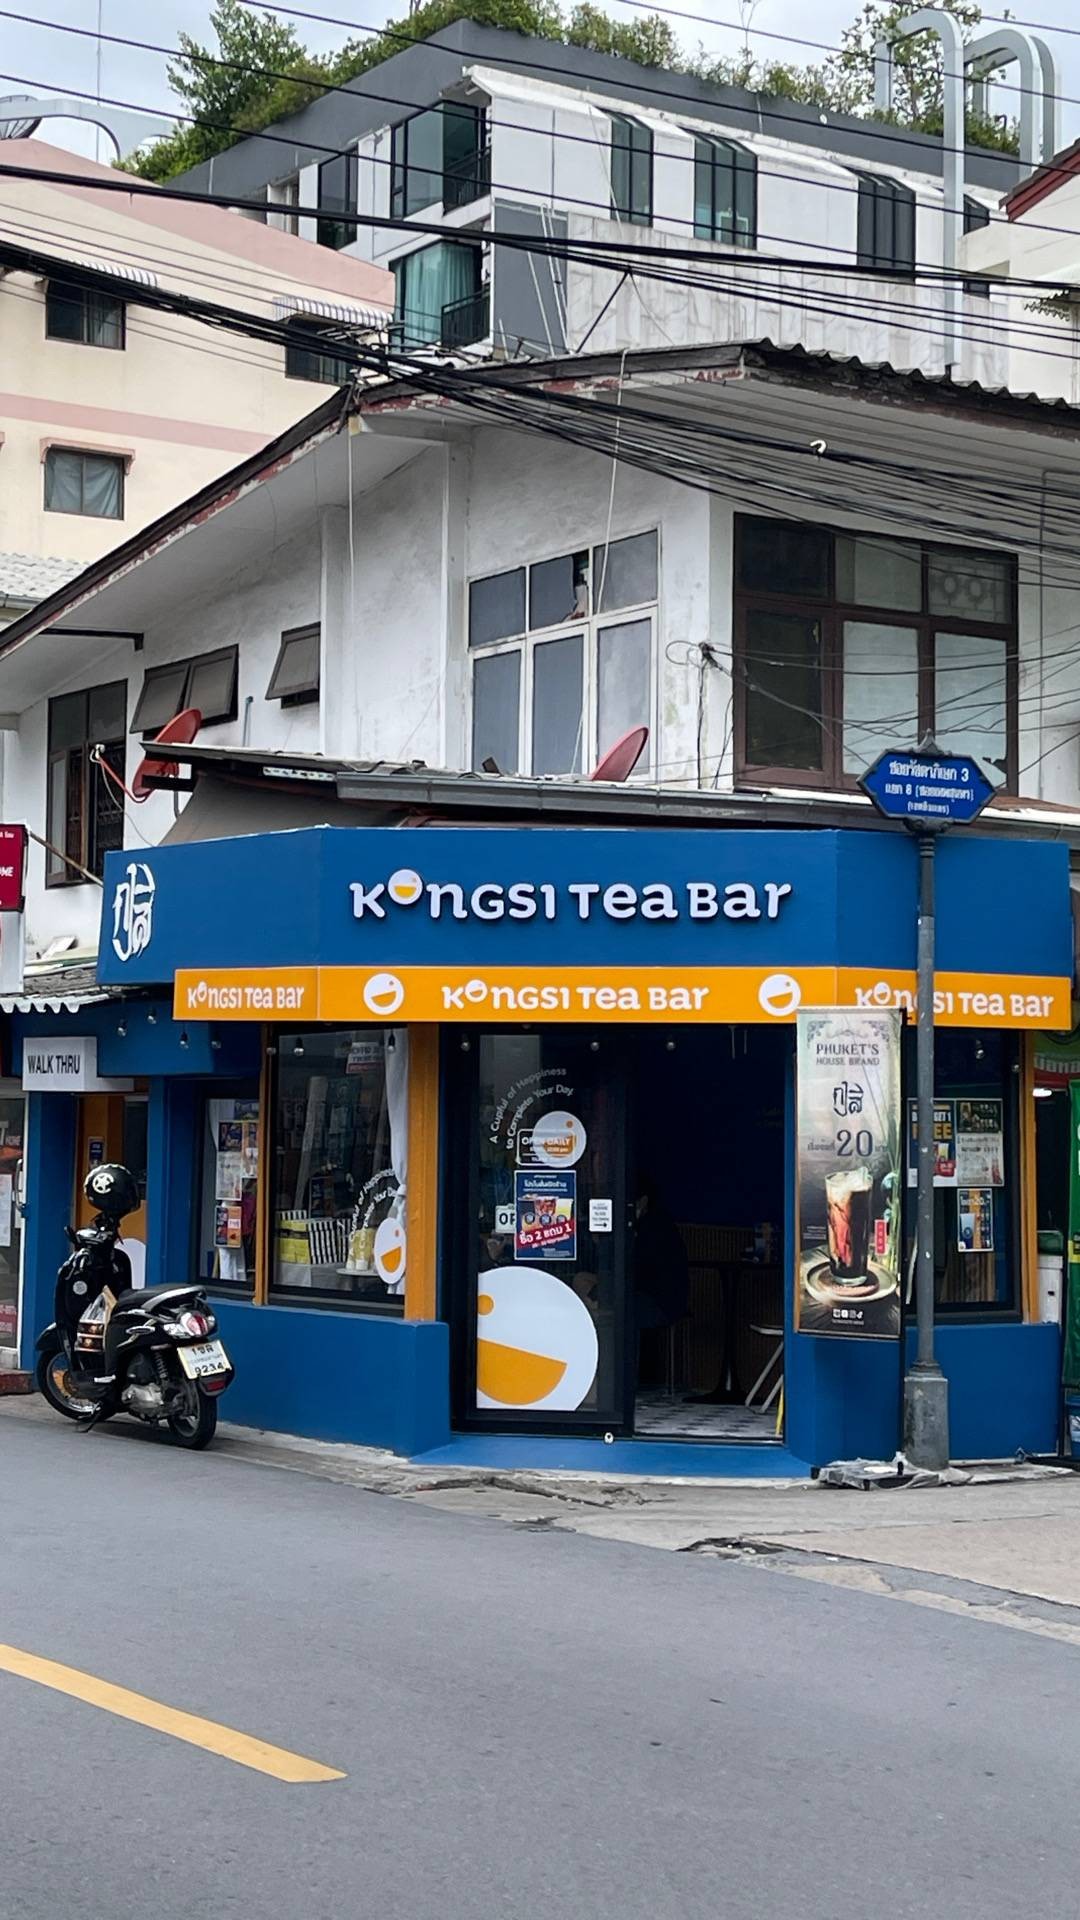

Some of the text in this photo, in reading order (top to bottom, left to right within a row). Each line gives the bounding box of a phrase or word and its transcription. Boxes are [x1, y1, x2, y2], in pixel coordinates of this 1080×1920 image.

[961, 768, 969, 782] 3
[905, 783, 912, 795] 8
[568, 883, 679, 919] Tea
[686, 883, 792, 918] Bar
[816, 1043, 880, 1056] PHUKET'S
[27, 1054, 80, 1074] WALK THRU
[816, 1057, 880, 1066] HOUSE BRAND
[533, 1087, 554, 1098] Your
[489, 1068, 567, 1144] A Cupful of Happiness
[507, 1097, 534, 1137] Complete
[506, 1138, 514, 1150] to
[836, 1129, 873, 1157] 20
[535, 1230, 542, 1240] 2
[565, 1222, 572, 1234] 1
